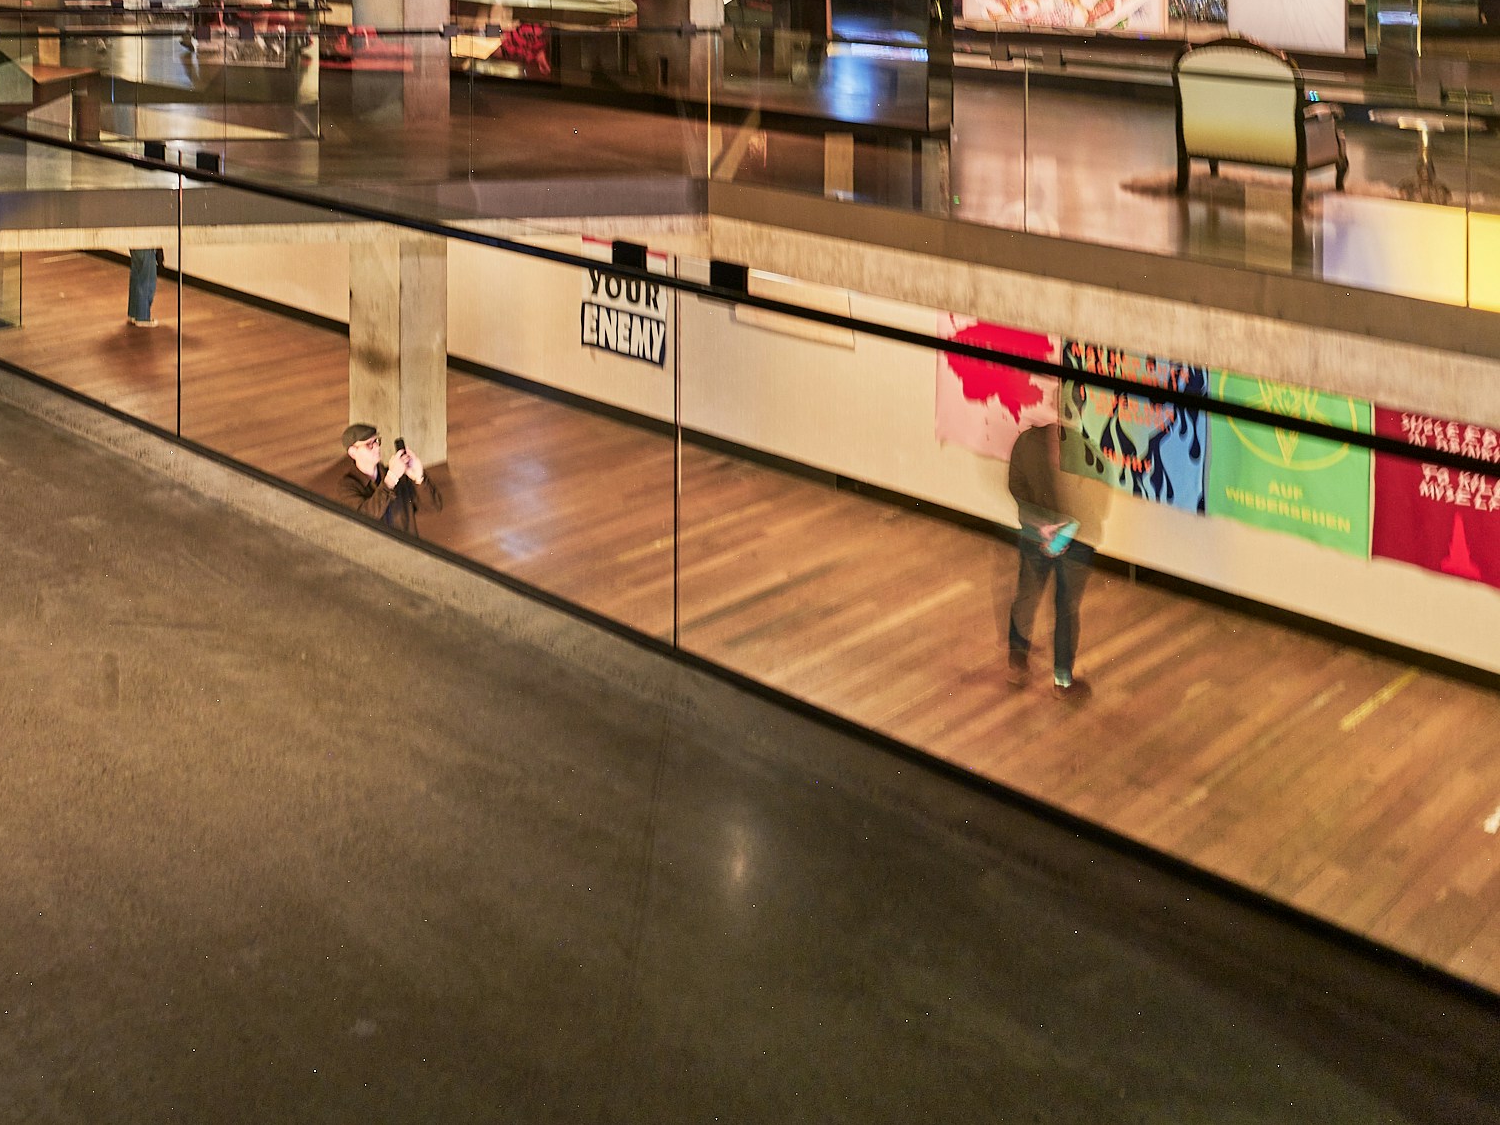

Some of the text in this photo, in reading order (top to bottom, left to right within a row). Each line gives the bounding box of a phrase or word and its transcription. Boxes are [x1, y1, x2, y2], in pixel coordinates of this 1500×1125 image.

[588, 268, 660, 311] YOUR
[582, 302, 666, 366] ENEMY
[1225, 485, 1350, 534] WIEDERSEHEN
[1268, 479, 1303, 500] AUF
